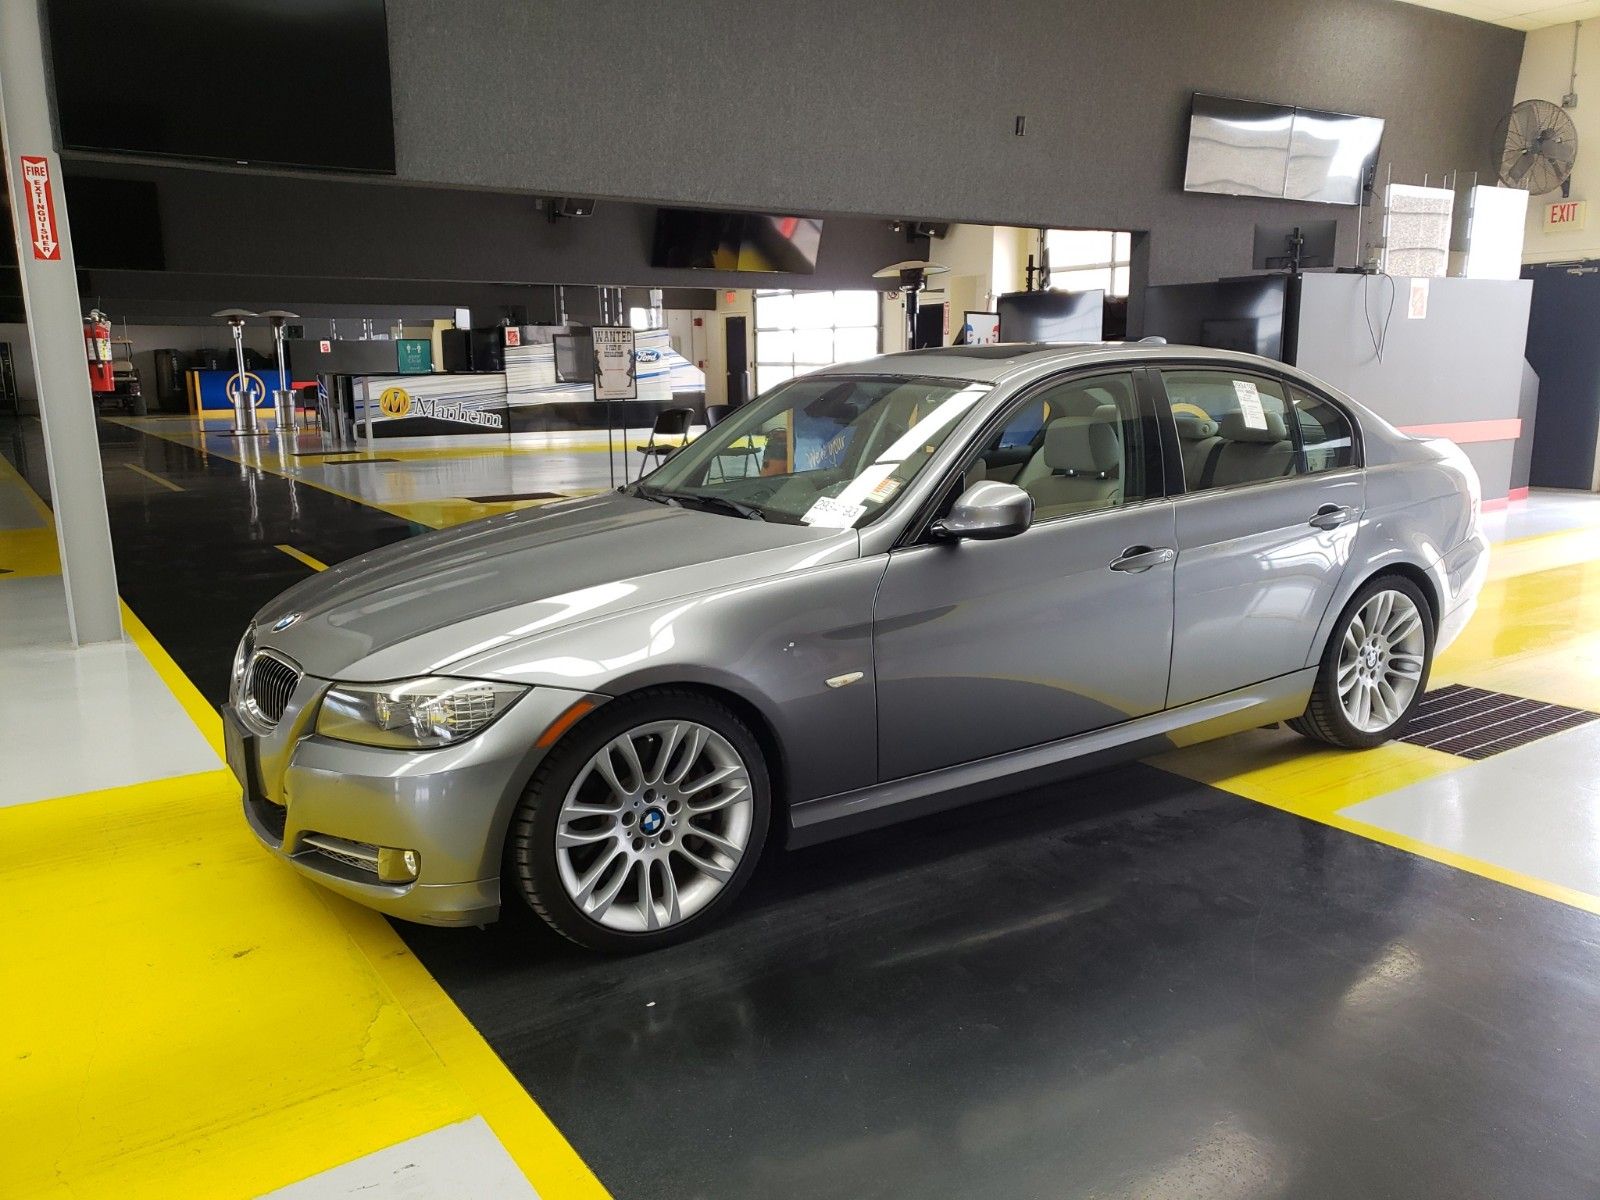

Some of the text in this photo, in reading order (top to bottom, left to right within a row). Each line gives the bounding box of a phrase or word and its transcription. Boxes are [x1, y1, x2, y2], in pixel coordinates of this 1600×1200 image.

[26, 166, 46, 176] FIRE
[34, 179, 51, 253] EXTINGUISHER
[1550, 203, 1578, 223] EXIT
[595, 330, 632, 342] WANTED
[636, 349, 658, 362] Ford
[414, 396, 503, 428] Manheim
